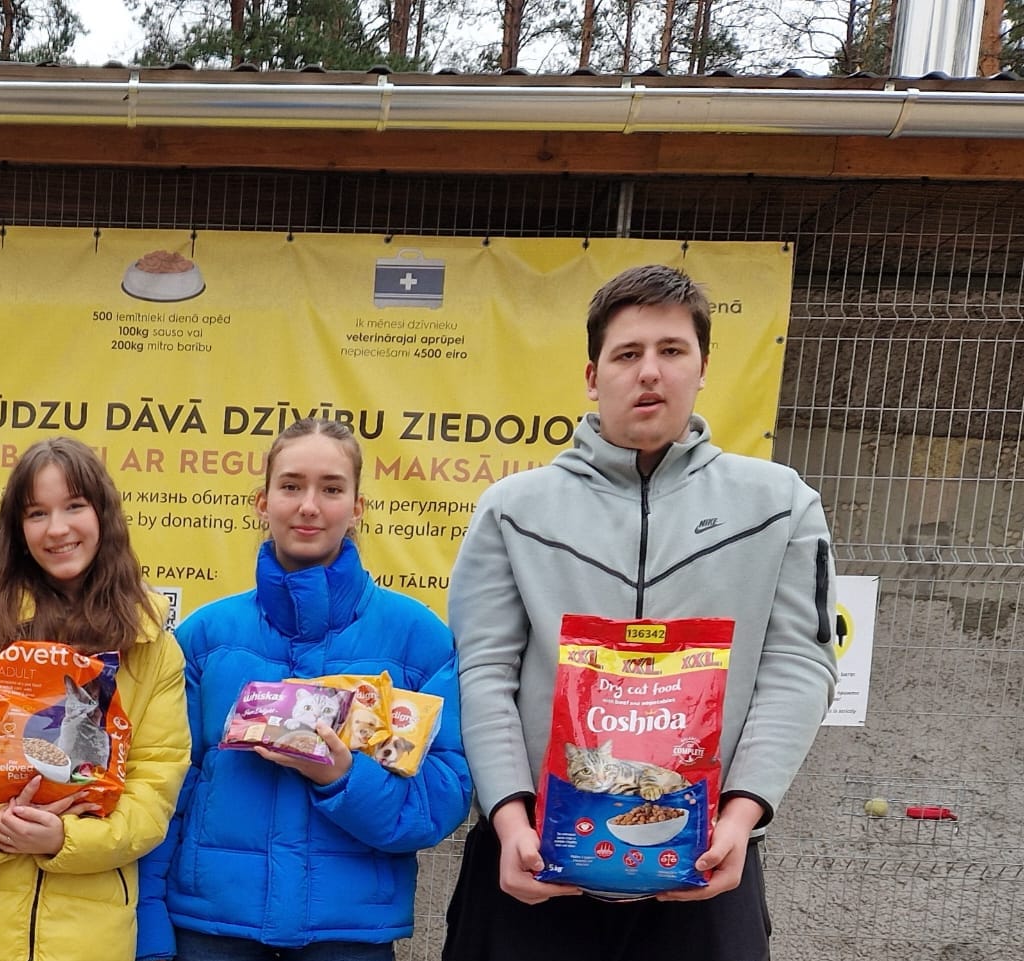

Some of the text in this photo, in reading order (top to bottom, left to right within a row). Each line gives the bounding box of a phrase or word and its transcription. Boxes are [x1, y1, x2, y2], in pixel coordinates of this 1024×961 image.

[93, 311, 113, 321] 500
[119, 326, 203, 338] 100kg sauso vai
[420, 334, 465, 346] aprūpei
[111, 340, 144, 352] 200kg
[414, 348, 442, 358] 4500
[445, 349, 468, 359] eiro
[106, 397, 207, 435] DĀVĀ
[399, 411, 583, 446] ZIEDOJO
[120, 448, 165, 473] AR
[179, 449, 267, 476] REGU
[136, 491, 187, 504] жизнь
[192, 489, 257, 506] обитате
[138, 511, 158, 530] by
[161, 512, 238, 533] donating.
[374, 523, 383, 534] a
[388, 521, 447, 540] regular
[156, 566, 218, 581] PAYPAL:
[399, 573, 450, 589] TĀLRU
[627, 629, 665, 639] 136342
[599, 678, 682, 698] Dry cat food
[586, 706, 687, 736] Coshida
